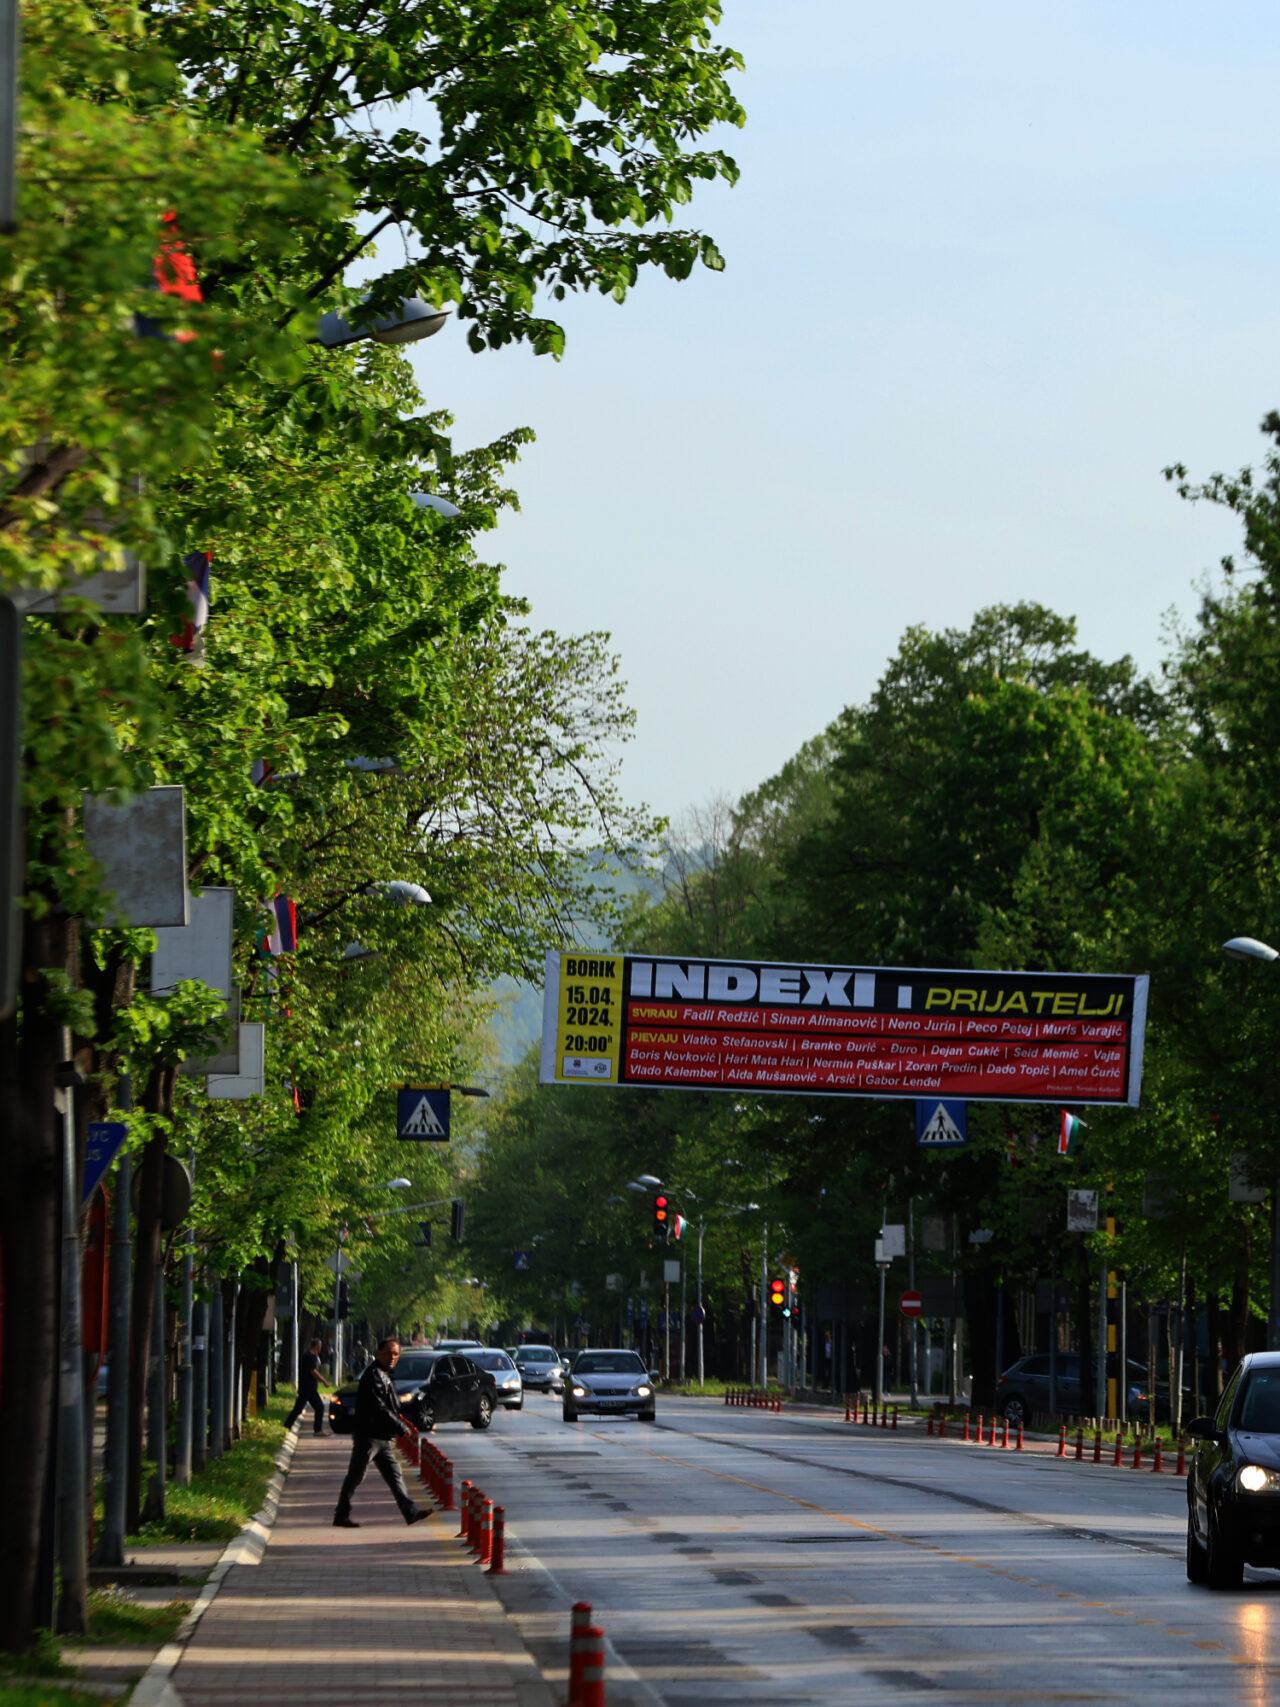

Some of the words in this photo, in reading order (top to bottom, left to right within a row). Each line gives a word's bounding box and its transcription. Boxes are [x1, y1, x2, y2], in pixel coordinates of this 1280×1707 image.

[566, 959, 616, 978] BORIK
[566, 986, 614, 1005] 15.04.
[630, 961, 876, 1008] INDEXI
[924, 987, 1124, 1016] PRIJATELJI
[566, 1007, 614, 1026] 2024.
[632, 1007, 678, 1019] SVIRAJU
[683, 1008, 715, 1021] Fadil
[717, 1010, 759, 1023] Redžić
[770, 1012, 805, 1026] Sinan
[808, 1014, 878, 1029] Alimanović
[888, 1018, 921, 1031] Neno
[924, 1019, 956, 1032] Jurin
[966, 1021, 998, 1033] Peco
[1000, 1022, 1033, 1036] Petej
[1042, 1024, 1077, 1037] Muris
[1081, 1025, 1123, 1039] Varajić
[630, 1031, 679, 1044] PJEVAJU
[683, 1033, 718, 1046] Vlatko
[722, 1036, 789, 1049] Stefanovski
[801, 1039, 842, 1051] Branko
[846, 1040, 877, 1053] Đurić
[890, 1042, 918, 1054] Đuro
[931, 1044, 963, 1057] Dejan
[1013, 1047, 1039, 1058] Seid
[1042, 1048, 1080, 1060] Memić
[1093, 1049, 1121, 1062] Vajta
[630, 1048, 661, 1061] Boris
[663, 1050, 716, 1064] Novković
[725, 1053, 749, 1065] Hari
[751, 1054, 778, 1067] Mata
[780, 1056, 805, 1068] Hari
[813, 1057, 854, 1070] Nermin
[856, 1059, 897, 1071] Puškar
[905, 1060, 938, 1072] Zoran
[941, 1061, 978, 1073] Predin
[986, 1063, 1017, 1075] Dado
[1019, 1064, 1050, 1078] Topić
[1059, 1065, 1088, 1077] Amel
[1091, 1065, 1121, 1078] Ćurić
[630, 1063, 662, 1076] Vlado
[664, 1066, 718, 1079] Kalember
[727, 1068, 754, 1080] Aida
[756, 1069, 817, 1083] Mušanović
[826, 1072, 856, 1084] Arsić
[865, 1074, 900, 1086] Gabor
[903, 1075, 942, 1088] Lenđel
